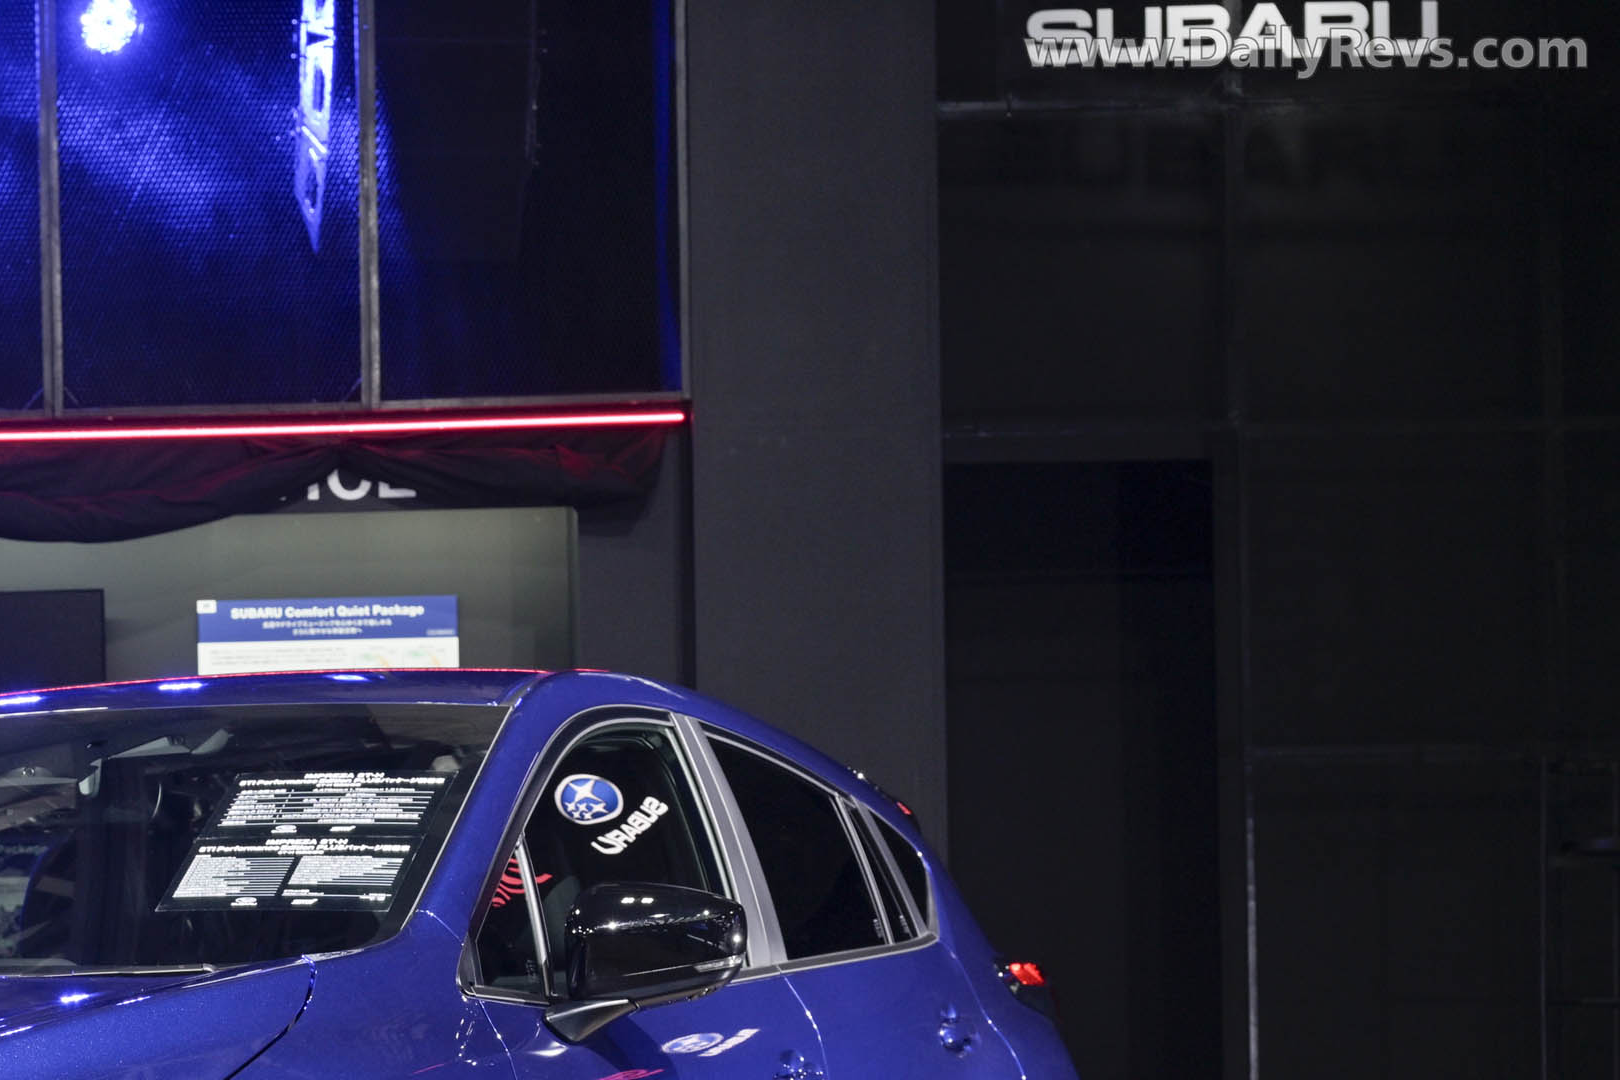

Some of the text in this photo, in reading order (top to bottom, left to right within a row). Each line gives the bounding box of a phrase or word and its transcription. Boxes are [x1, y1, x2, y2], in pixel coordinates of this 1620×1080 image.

[1025, 0, 1438, 64] SUBARU
[230, 603, 425, 620] SUBARU Comfort Quiet Package
